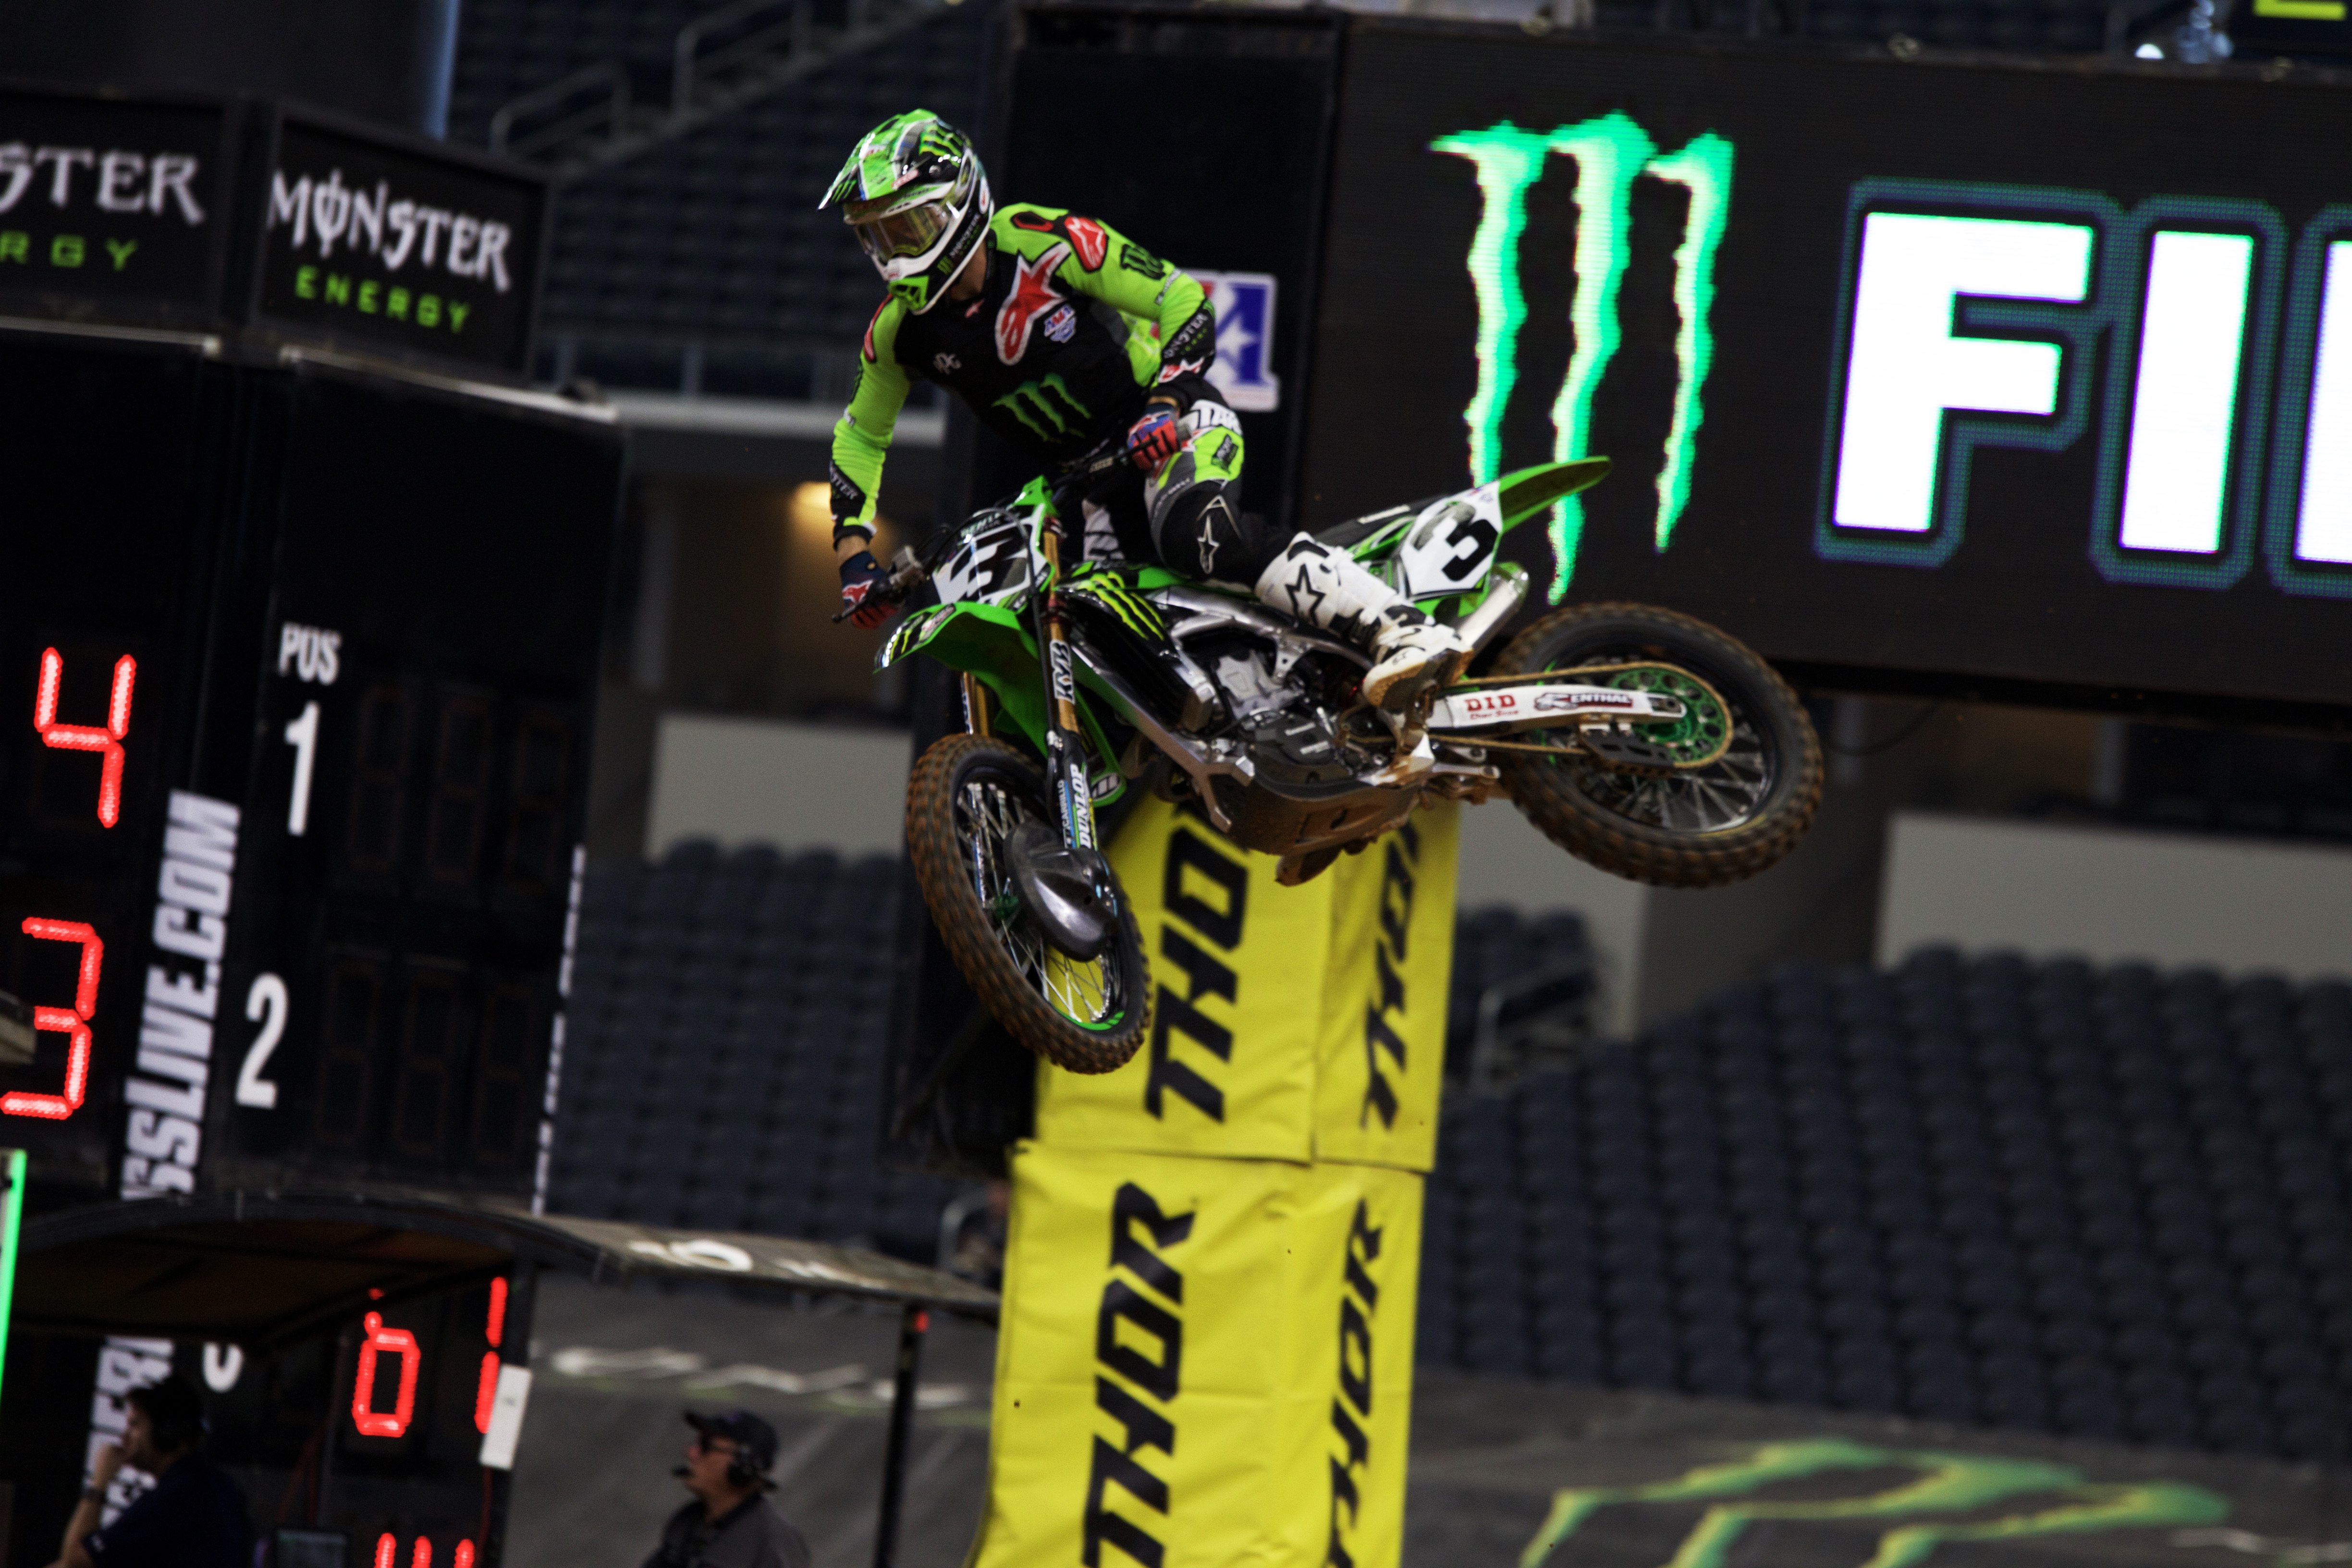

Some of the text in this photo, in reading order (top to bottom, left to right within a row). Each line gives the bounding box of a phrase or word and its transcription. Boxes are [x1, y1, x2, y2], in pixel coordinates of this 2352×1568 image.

[267, 167, 511, 293] MONSTER
[295, 266, 470, 333] ENERGY
[1411, 501, 1499, 582] 3
[279, 623, 342, 685] POS
[34, 646, 137, 828] 4
[284, 701, 320, 835] 1
[1070, 763, 1092, 849] DUNLOP
[0, 916, 104, 1120] 3
[1143, 798, 1251, 1125] THO
[235, 973, 288, 1108] 2
[1081, 1181, 1198, 1568] THOR
